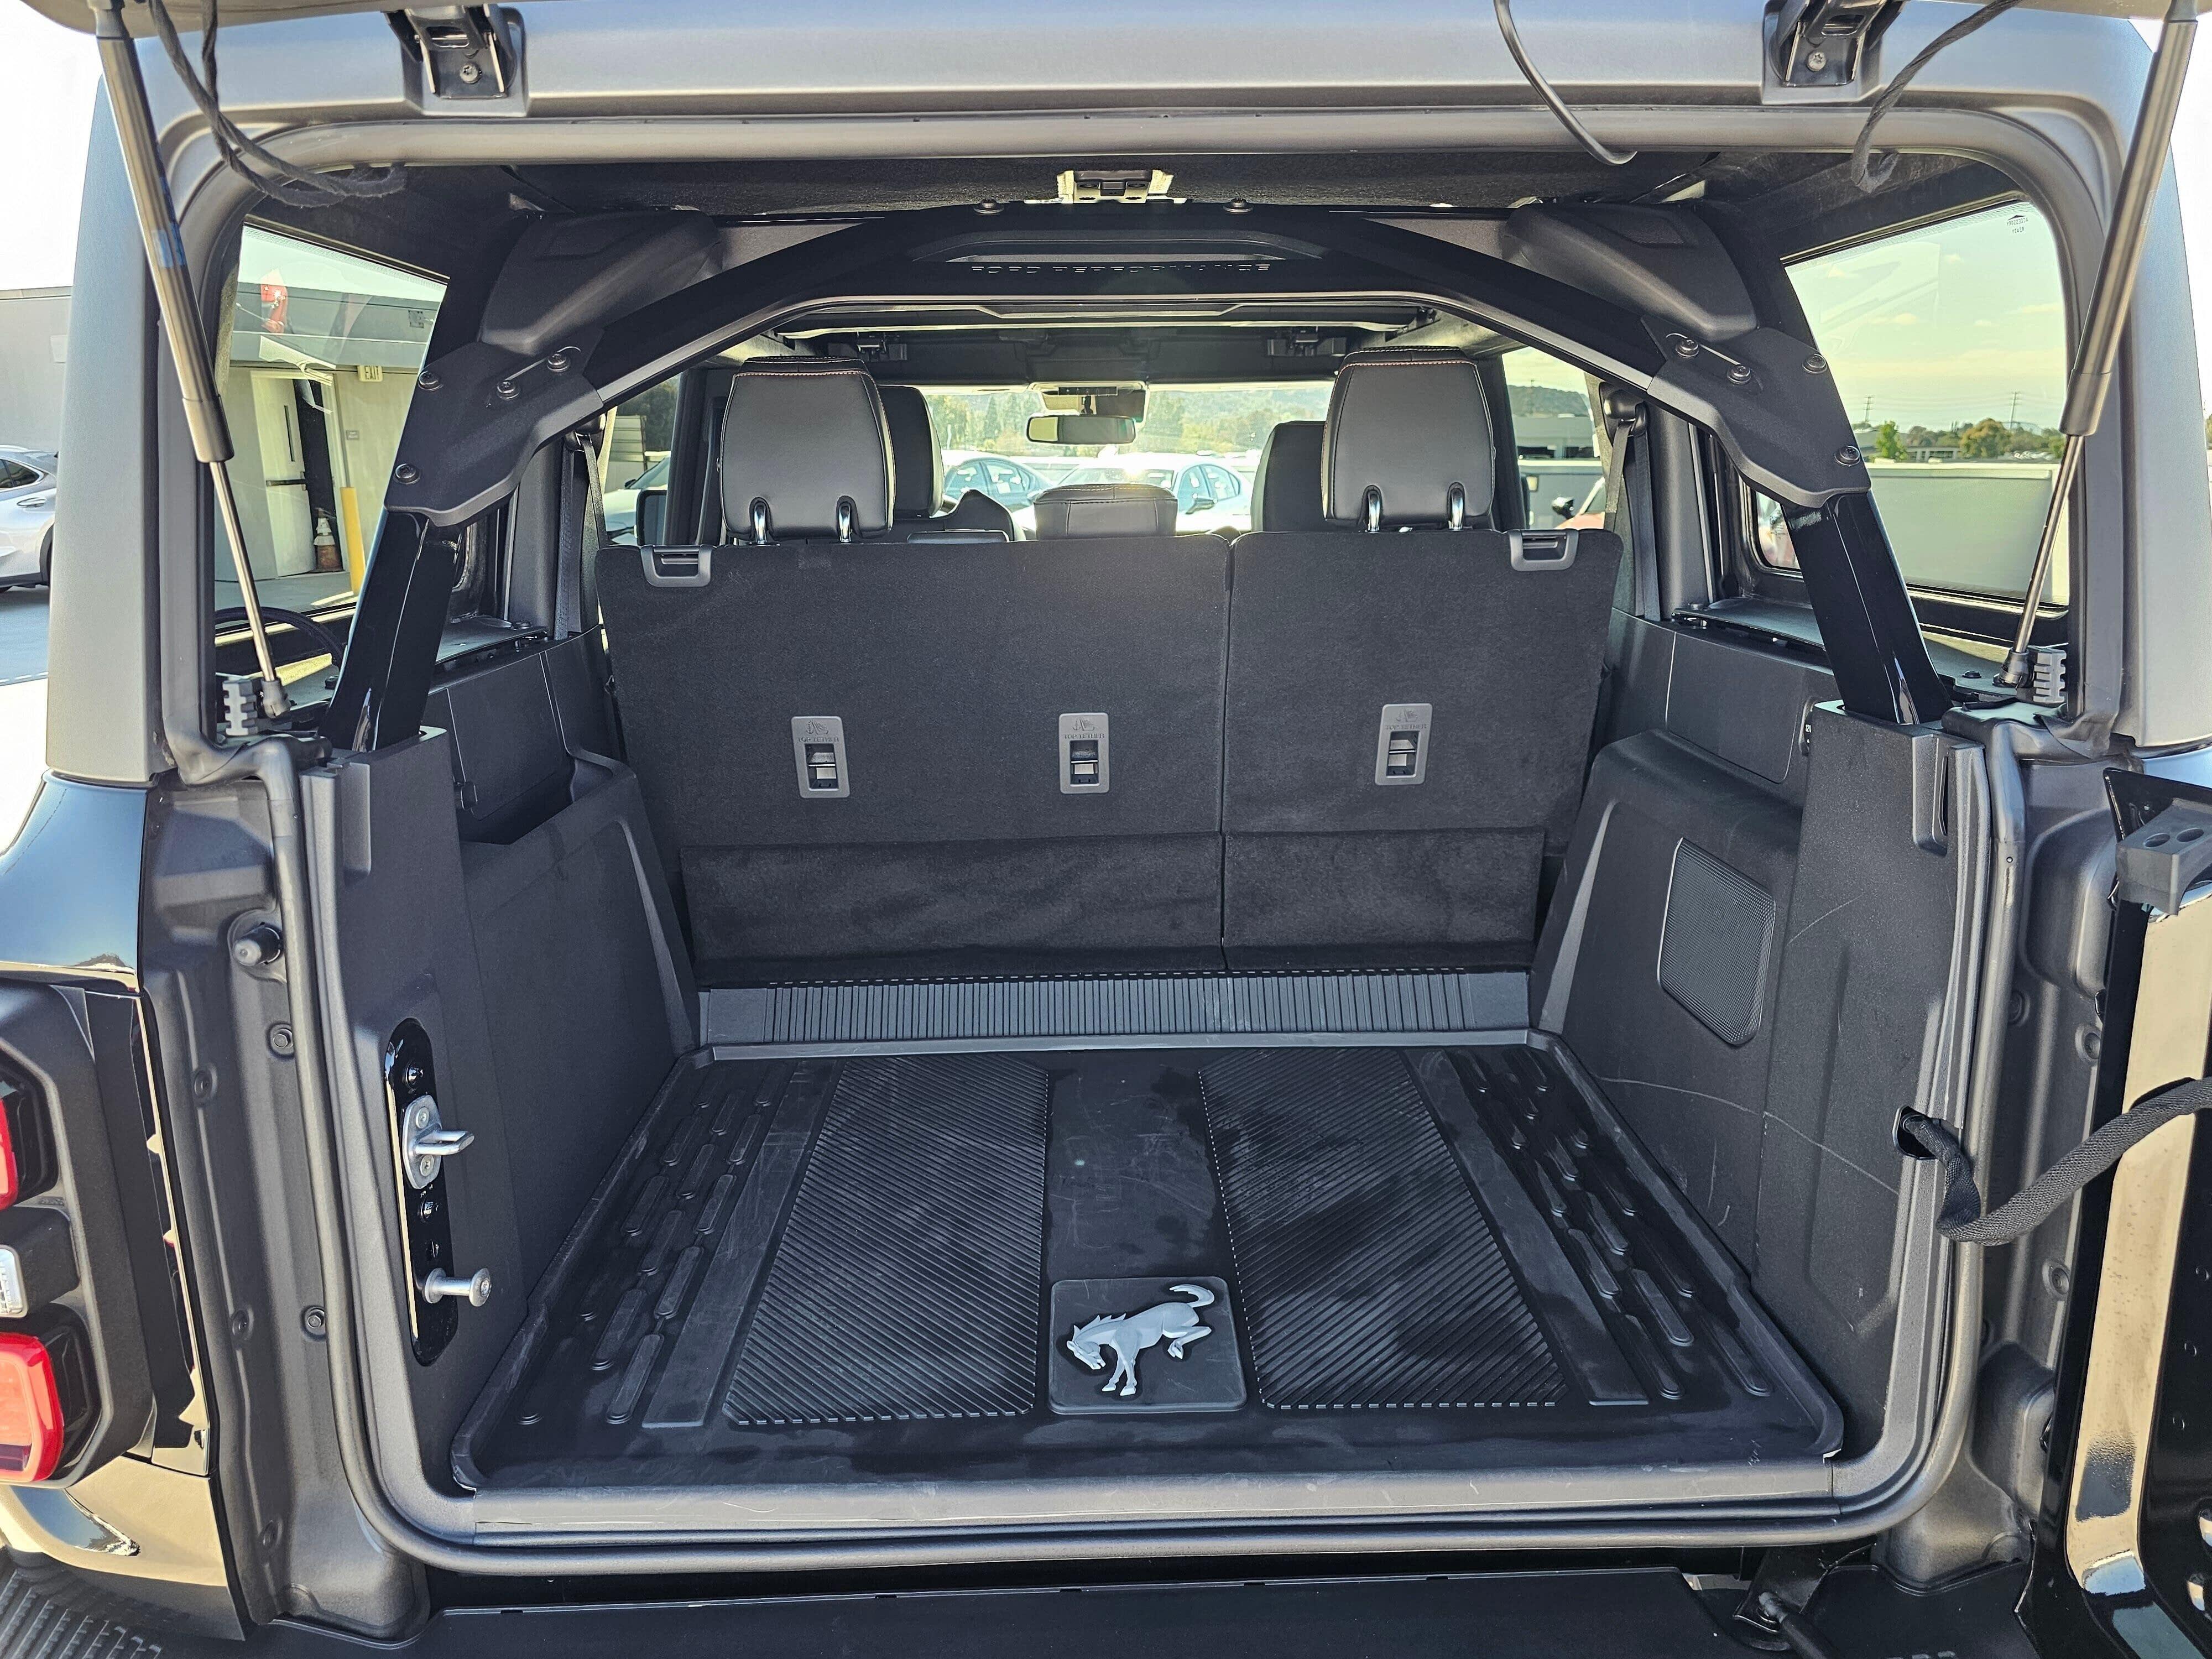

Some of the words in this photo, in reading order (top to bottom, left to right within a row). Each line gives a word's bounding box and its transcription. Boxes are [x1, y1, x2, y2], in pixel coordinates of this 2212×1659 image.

[971, 265, 1041, 274] FORD
[1052, 264, 1271, 273] PERFORMANCE
[364, 365, 380, 380] EXIT
